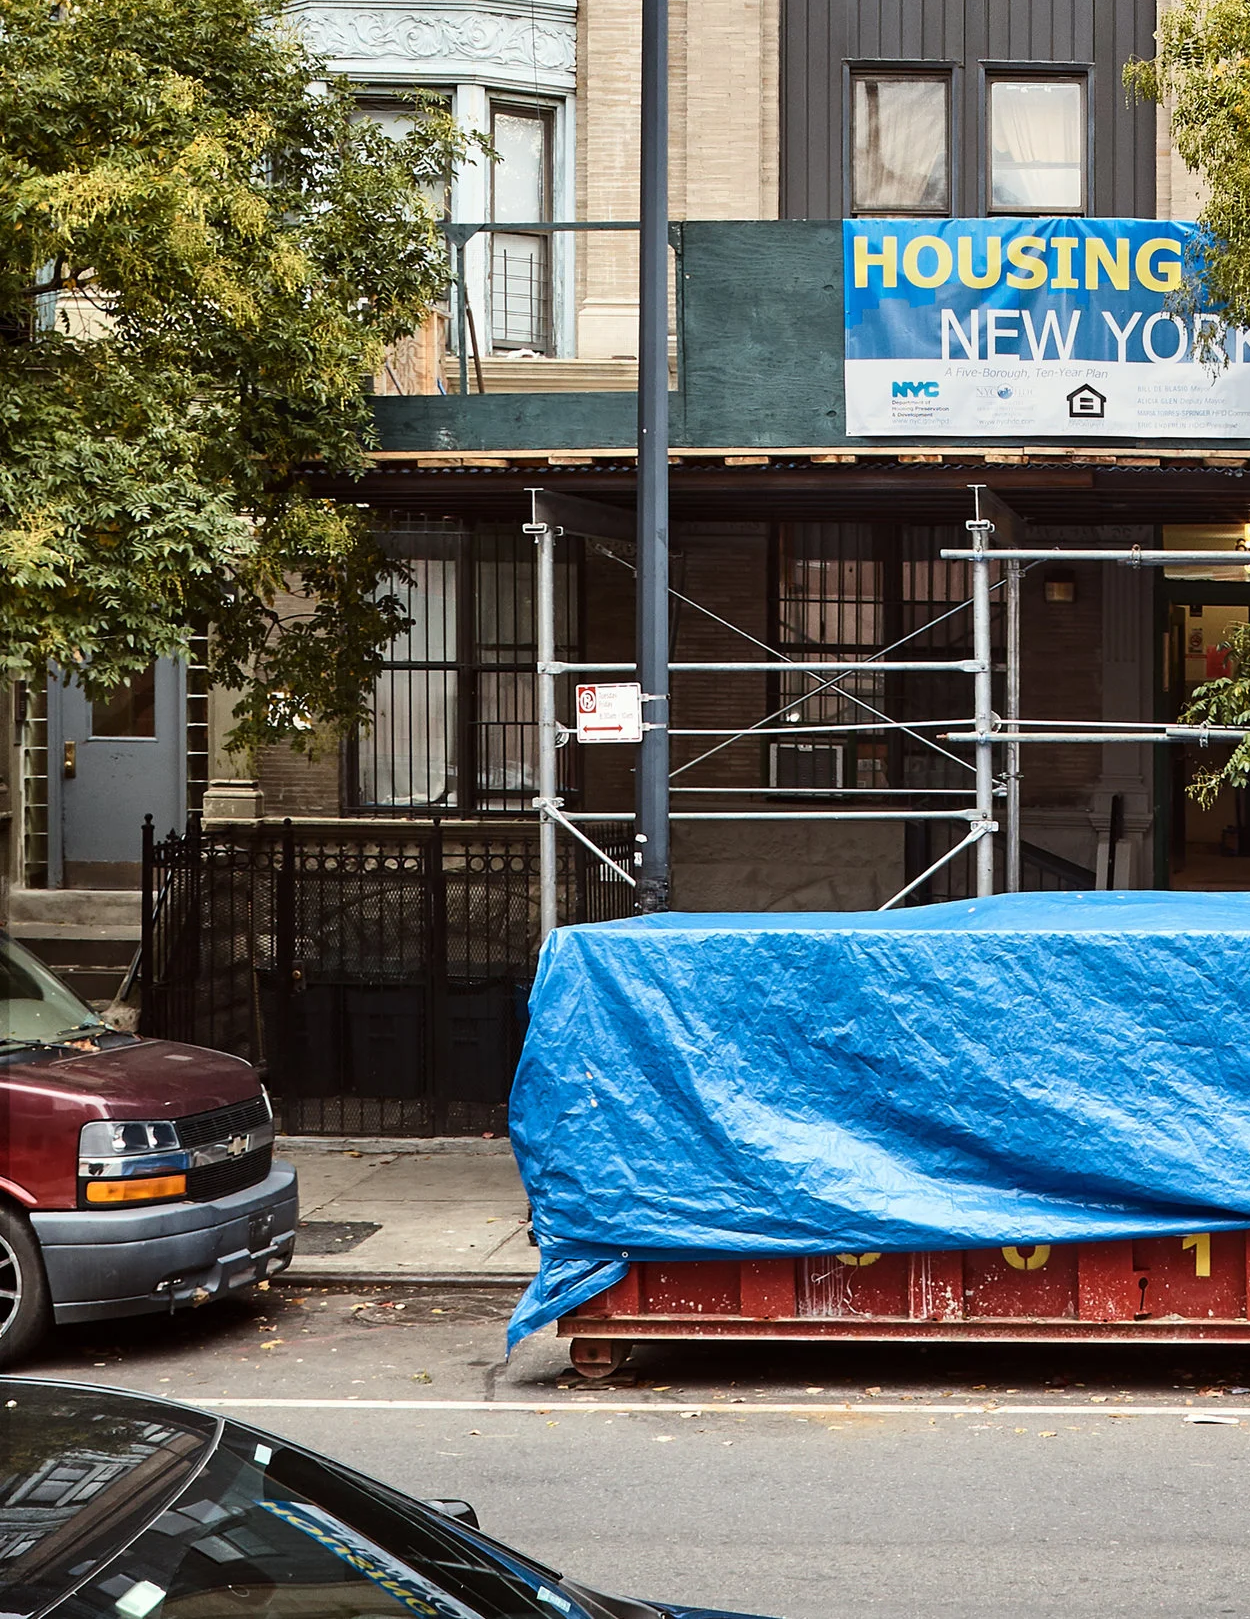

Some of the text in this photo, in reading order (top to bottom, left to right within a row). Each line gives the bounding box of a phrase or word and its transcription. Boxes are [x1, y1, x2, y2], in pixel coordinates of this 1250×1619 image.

[853, 235, 1182, 293] HOUSING
[941, 308, 1081, 361] NEW
[892, 381, 939, 398] NYC
[945, 367, 1109, 380] A Five-Borough, Ten-Year Plan
